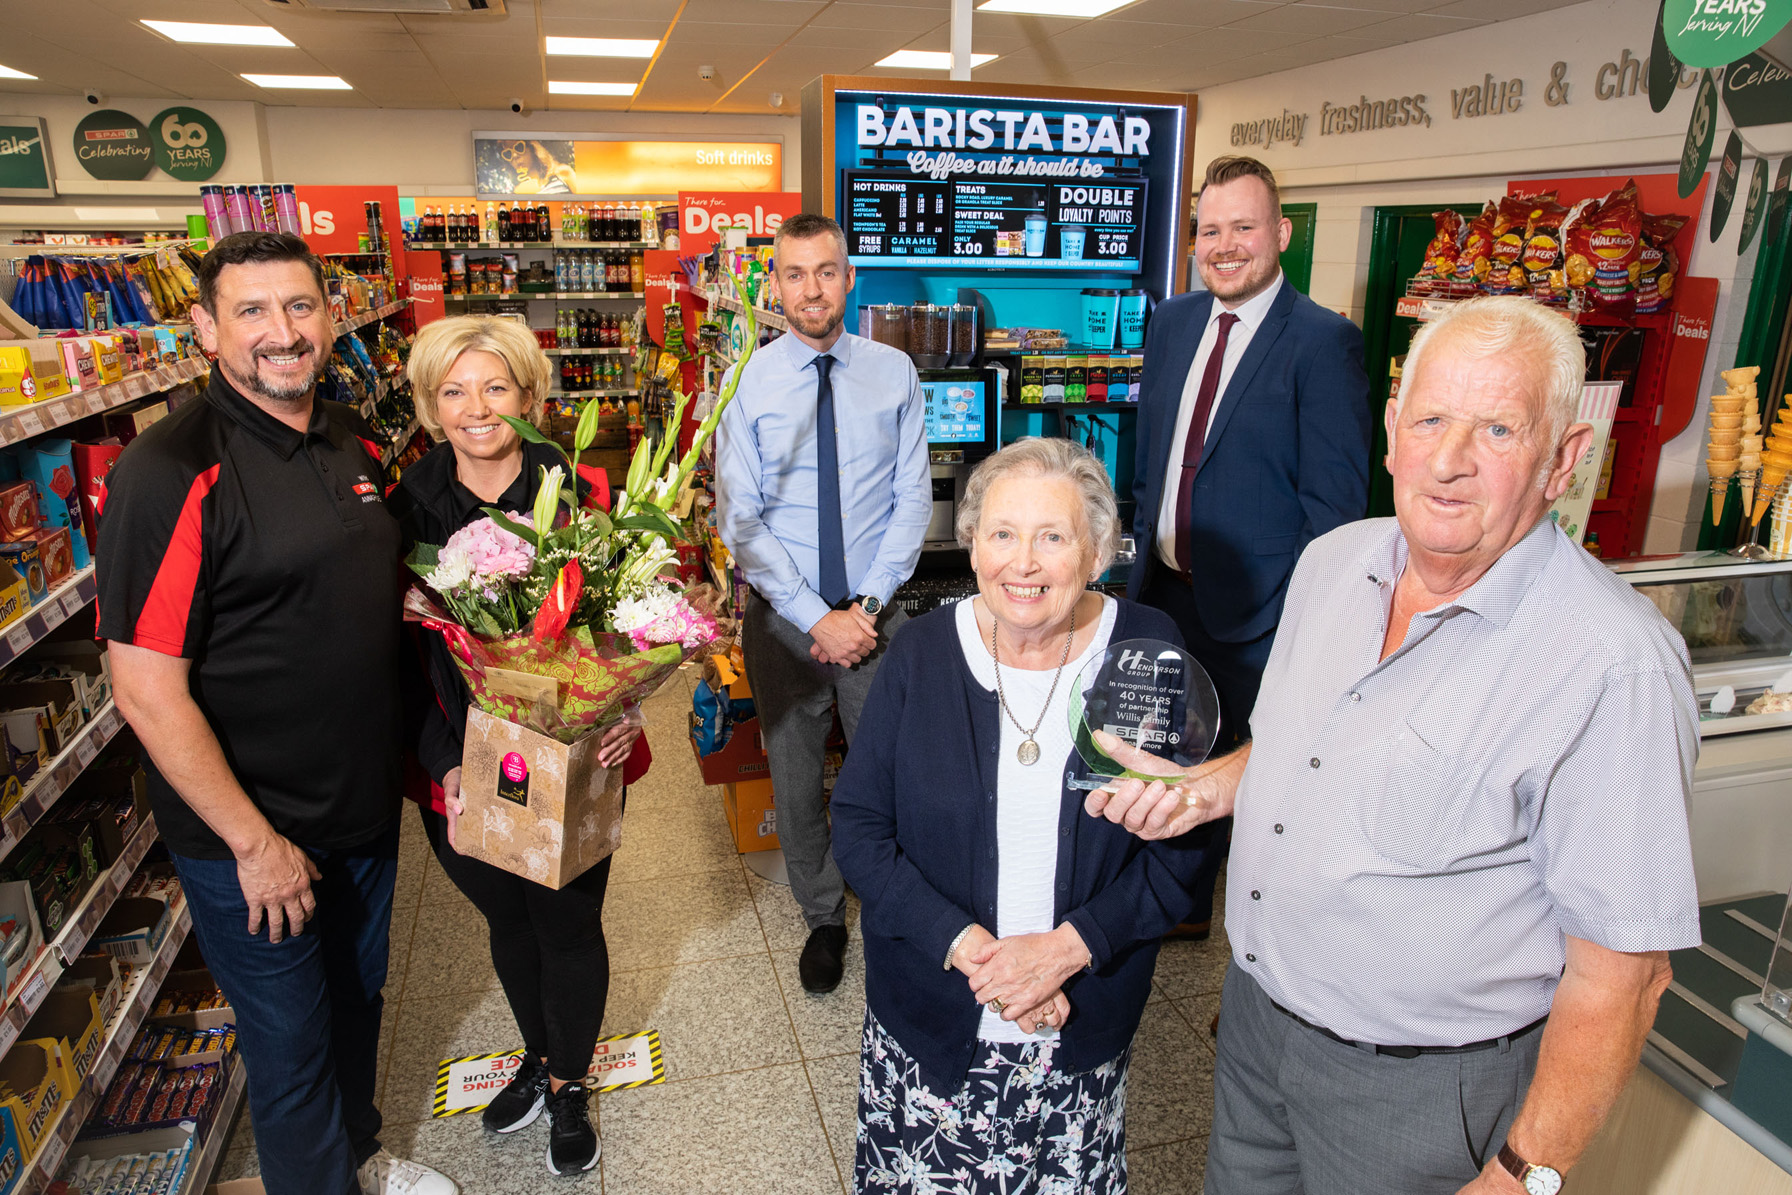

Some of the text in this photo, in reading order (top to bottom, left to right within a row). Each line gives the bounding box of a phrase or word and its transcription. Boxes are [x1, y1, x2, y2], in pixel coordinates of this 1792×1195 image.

[1694, 0, 1766, 15] YEARS
[1678, 13, 1764, 41] Serving NI
[1230, 61, 1569, 151] everyday freshness, value &
[95, 130, 125, 138] SPAR
[161, 114, 208, 149] 60
[857, 104, 1151, 155] BARISTA BAR
[0, 136, 31, 155] als
[79, 145, 151, 160] Celebrating
[167, 148, 210, 160] YEARS
[696, 148, 773, 166] Soft drinks
[169, 158, 212, 171] Serving NI
[906, 151, 1104, 180] Coffee as it should be
[853, 183, 906, 192] HOT DRINKS
[955, 185, 986, 194] TREATS
[685, 196, 707, 206] There
[1060, 187, 1134, 206] DOUBLE
[685, 206, 783, 235] Deals
[954, 211, 1004, 220] SWEET DEAL
[1059, 208, 1132, 223] LOYALTY POINTS
[859, 236, 937, 245] FREE CARAMEL
[1591, 236, 1633, 246] WALKERS
[858, 245, 881, 253] SYRUPS
[953, 242, 982, 254] 3.00
[1098, 241, 1127, 254] 3.00
[1641, 250, 1661, 259] KERS
[413, 282, 443, 291] Deals
[1396, 302, 1420, 315] Deal
[1676, 325, 1709, 339] Deals
[1117, 682, 1158, 692] recognition
[1119, 691, 1171, 705] 40 YEARS
[1116, 711, 1141, 722] Willis
[463, 1051, 636, 1083] KEEP YOUR
[588, 1058, 637, 1073] SOCIA
